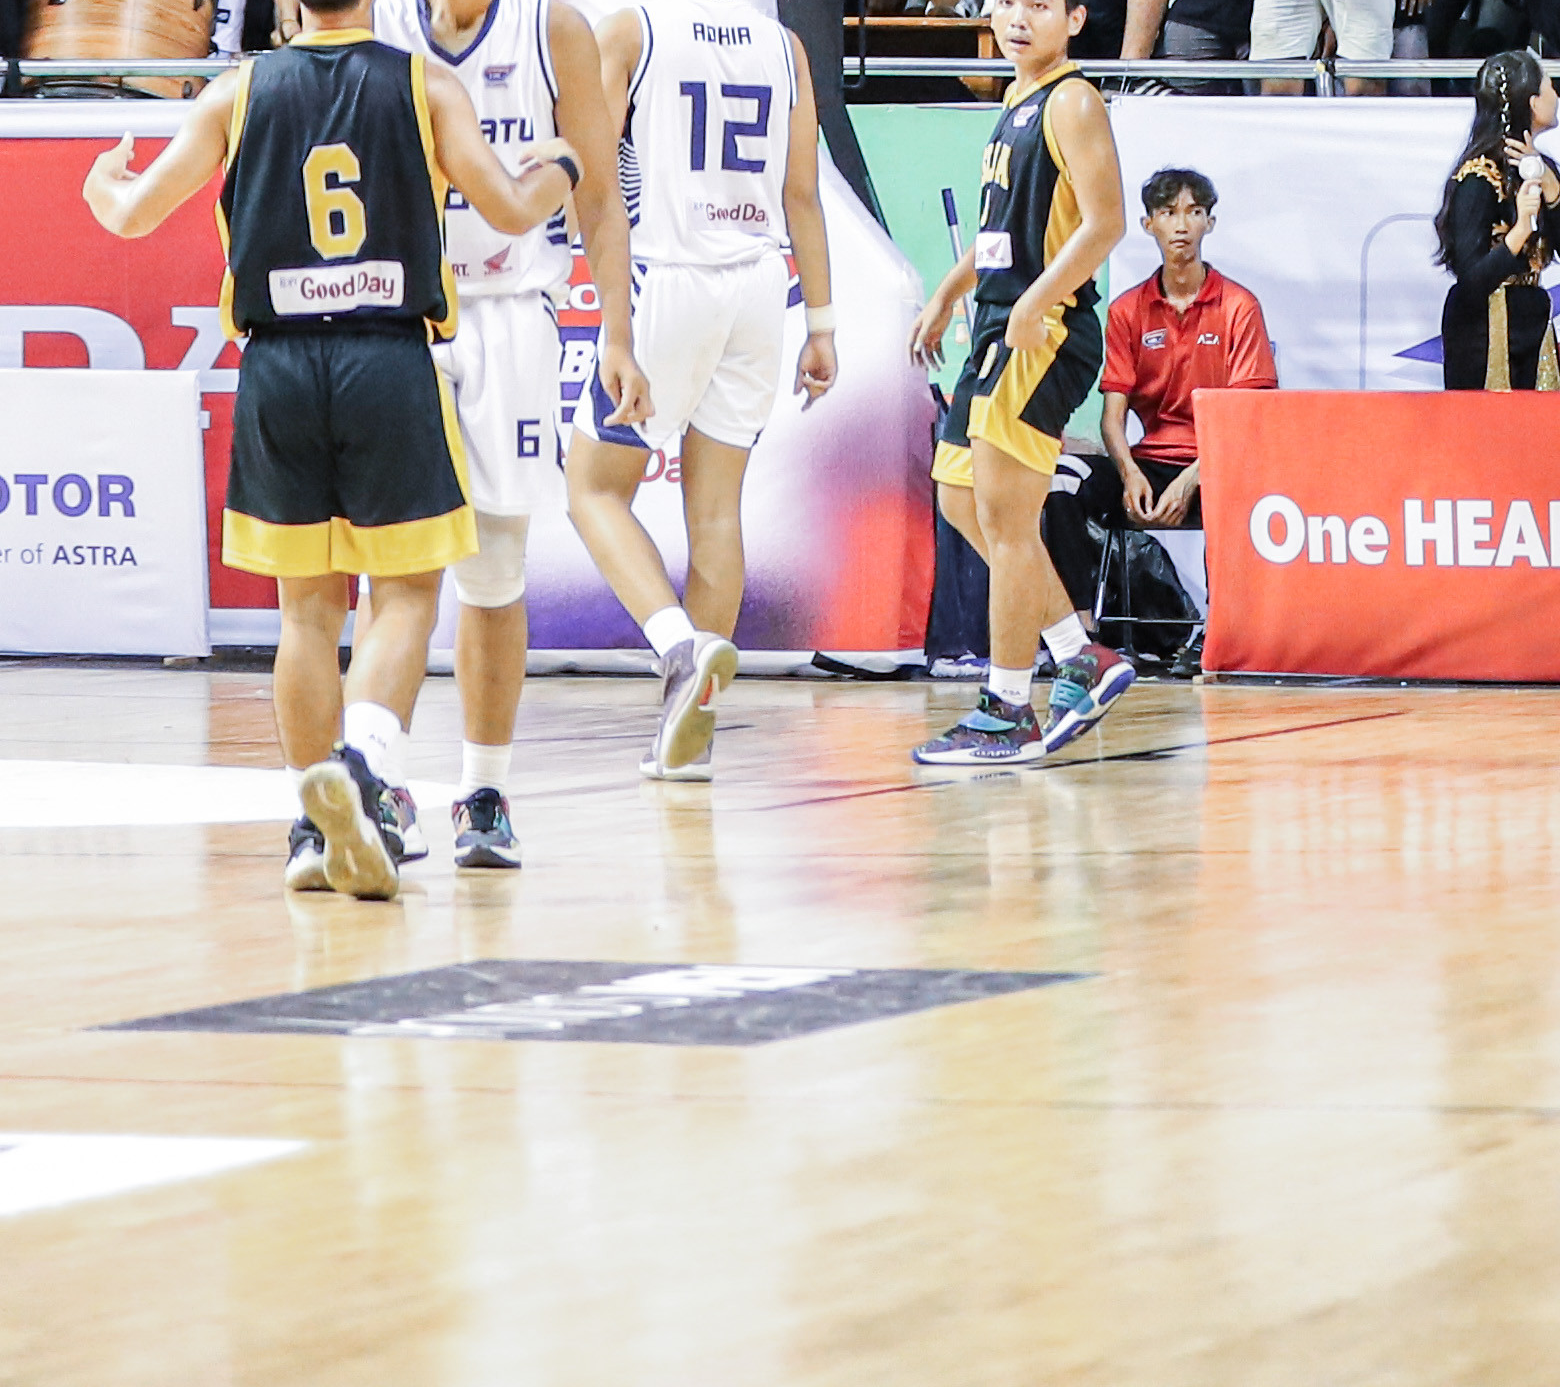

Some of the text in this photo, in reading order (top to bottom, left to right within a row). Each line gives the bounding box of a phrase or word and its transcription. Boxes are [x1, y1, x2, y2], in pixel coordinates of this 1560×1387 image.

[693, 22, 752, 46] ADHIA
[680, 81, 772, 174] 12
[302, 142, 367, 260] 6
[300, 270, 395, 301] Good Day
[517, 419, 540, 457] 6
[1249, 494, 1389, 566] One
[19, 541, 44, 565] of
[52, 545, 138, 567] ASTRA
